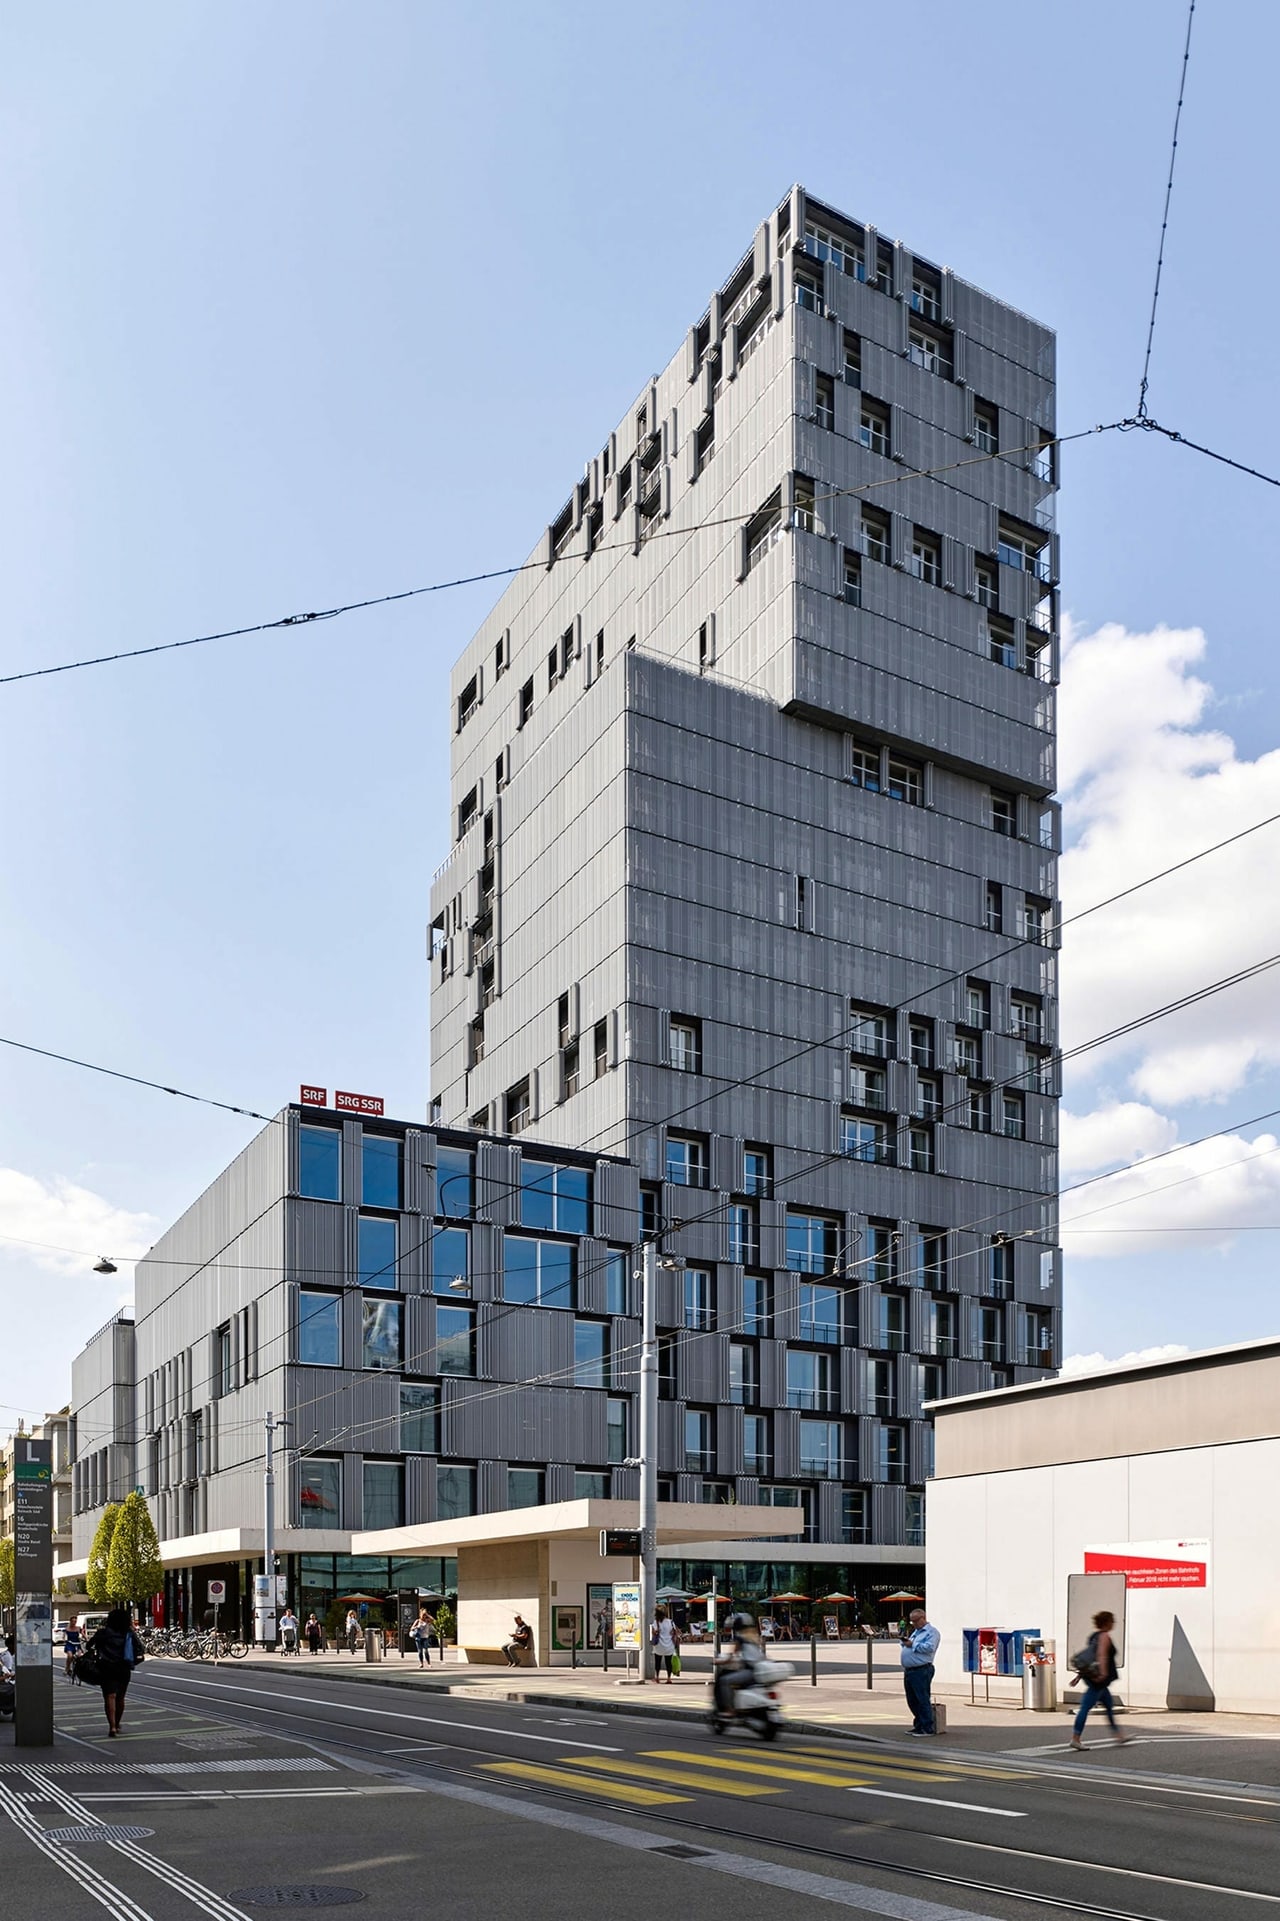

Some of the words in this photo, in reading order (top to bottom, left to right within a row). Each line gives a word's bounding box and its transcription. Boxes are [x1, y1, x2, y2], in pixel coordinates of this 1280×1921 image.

[303, 1090, 324, 1101] SRF
[337, 1095, 359, 1107] SRG
[361, 1098, 382, 1111] SSR
[26, 1442, 40, 1462] L
